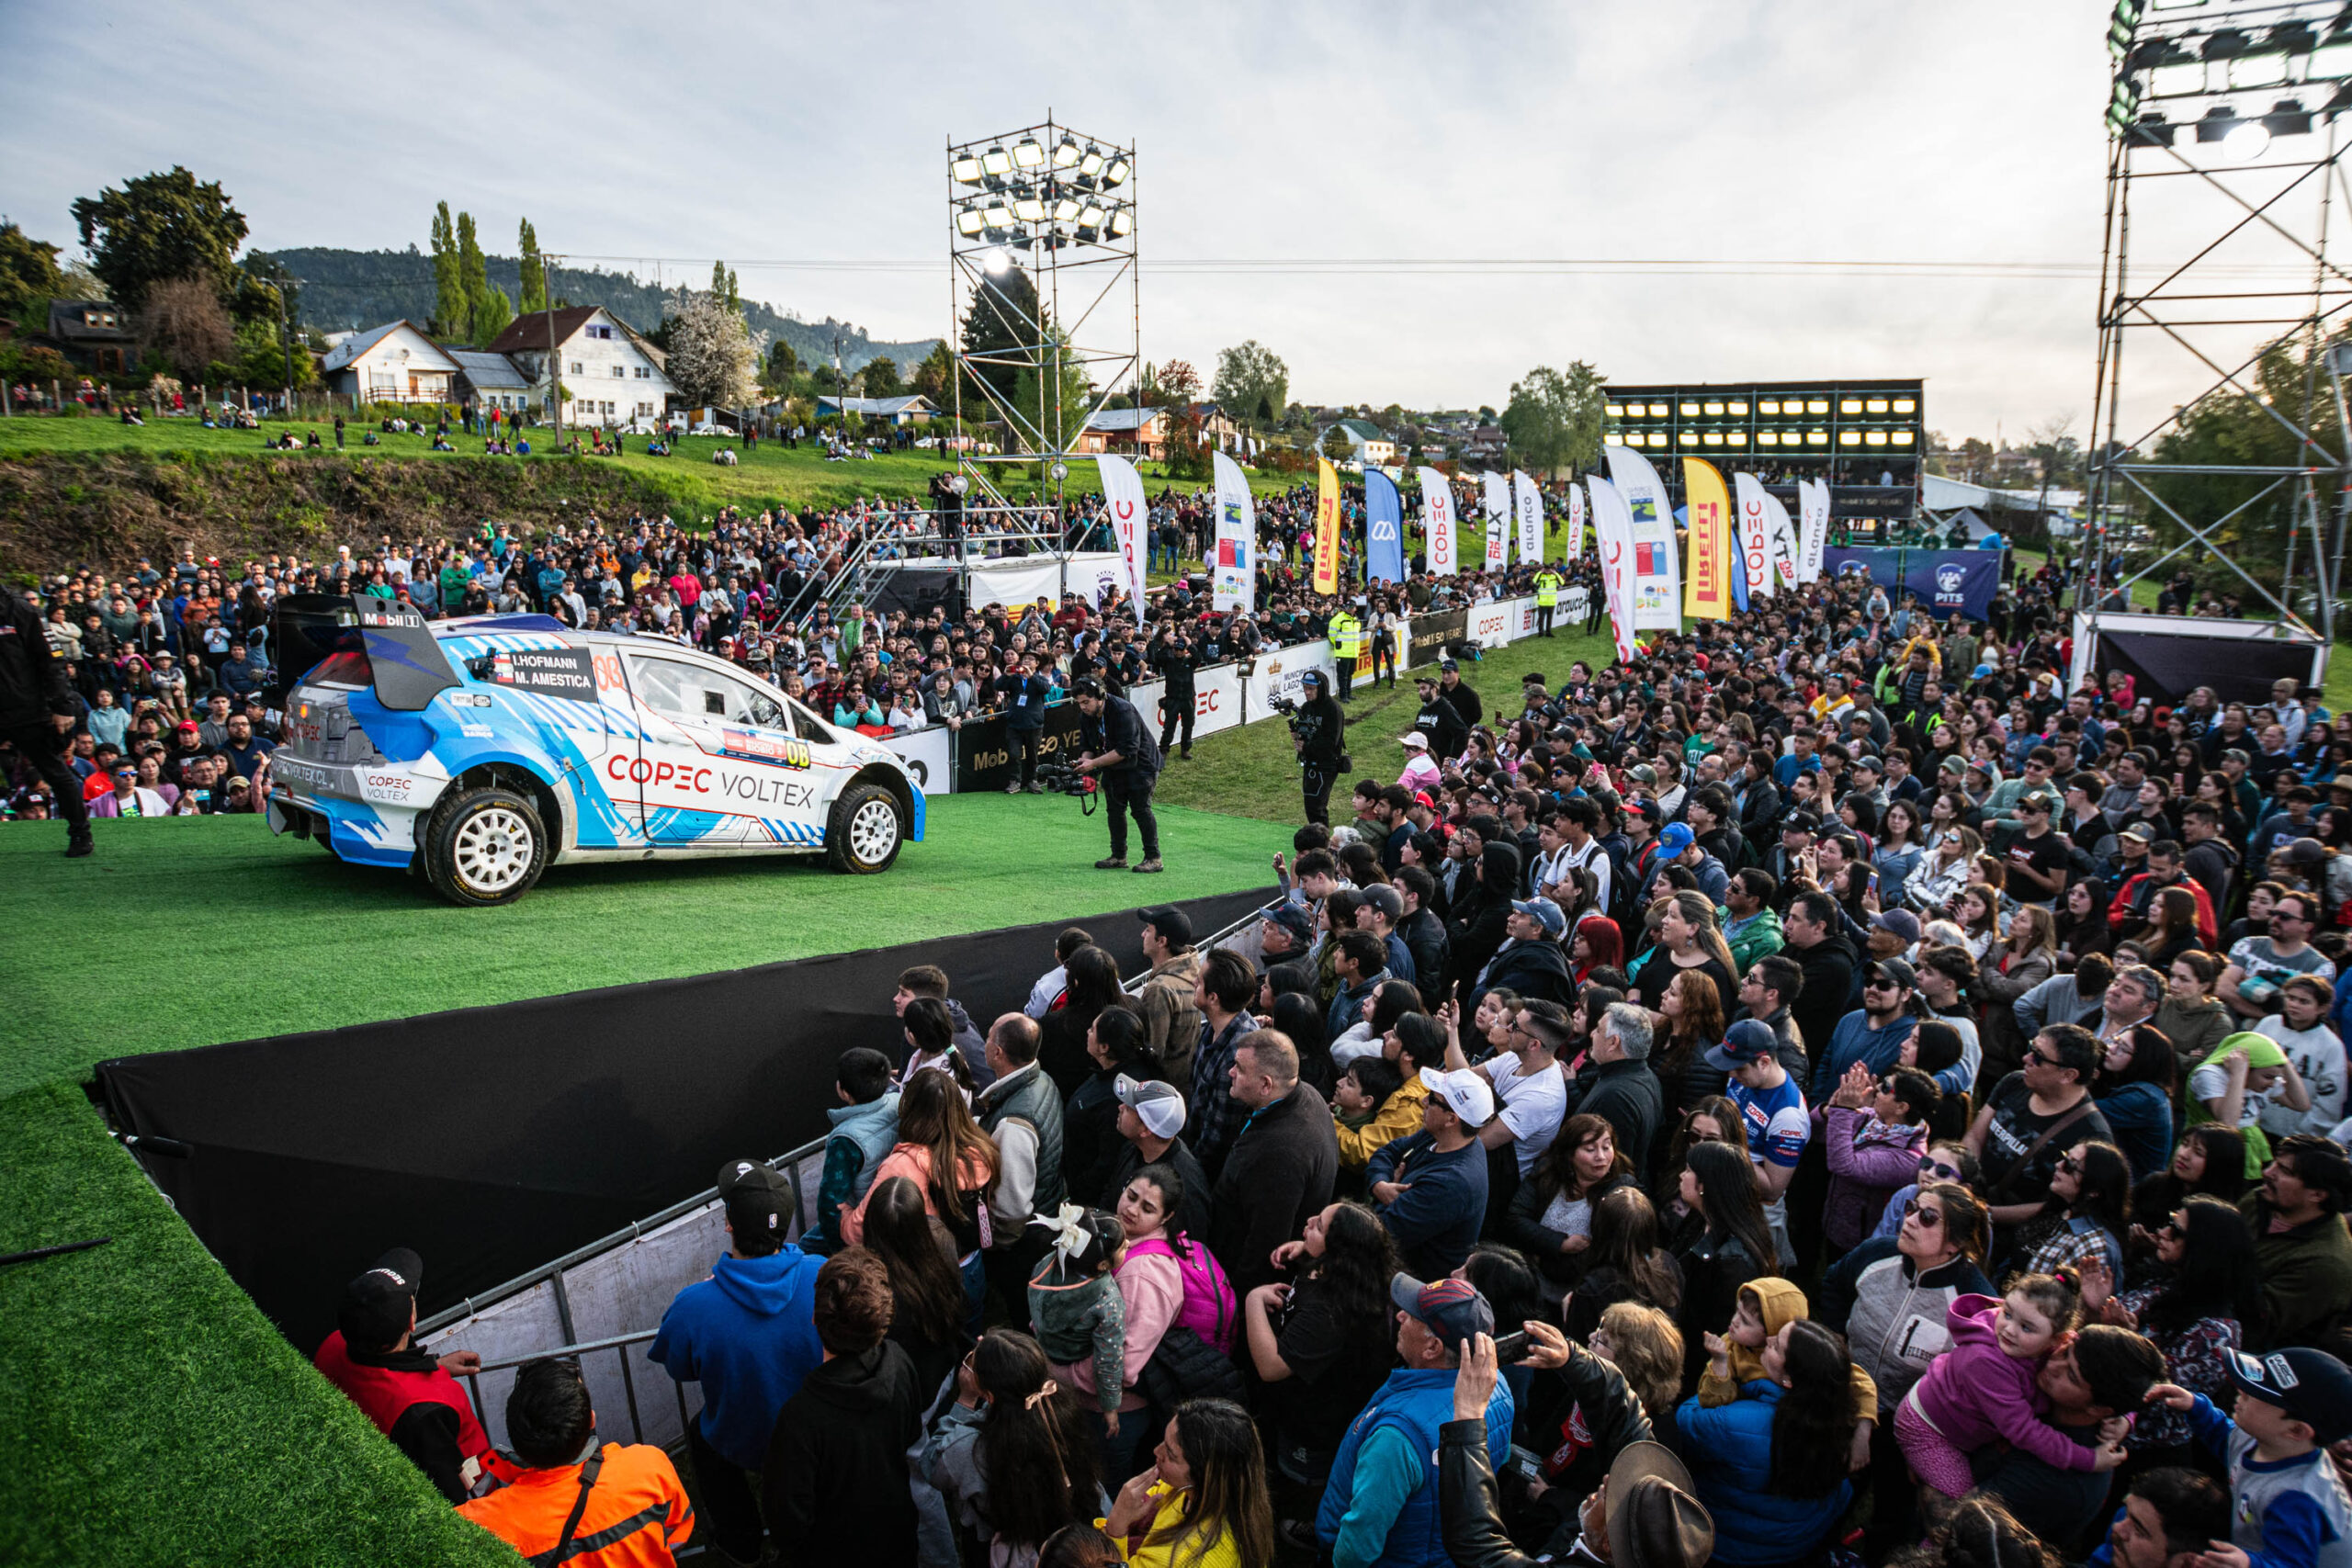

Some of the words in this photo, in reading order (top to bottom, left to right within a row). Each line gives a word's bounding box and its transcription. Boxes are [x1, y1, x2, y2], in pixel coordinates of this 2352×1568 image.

[1935, 592, 1964, 604] PITS
[364, 613, 404, 626] Mobil
[1478, 615, 1504, 636] COPEC
[513, 655, 578, 670] I.HOFMANN
[514, 671, 529, 684] M.
[531, 671, 592, 688] AMESTICA
[1283, 680, 1300, 692] LAGO
[1158, 689, 1219, 727] CEC
[368, 775, 412, 790] COPEC
[608, 755, 712, 794] COPEC
[722, 772, 814, 809] VOLTEX
[368, 788, 410, 802] VOLTEX
[1747, 1103, 1769, 1125] COPEC
